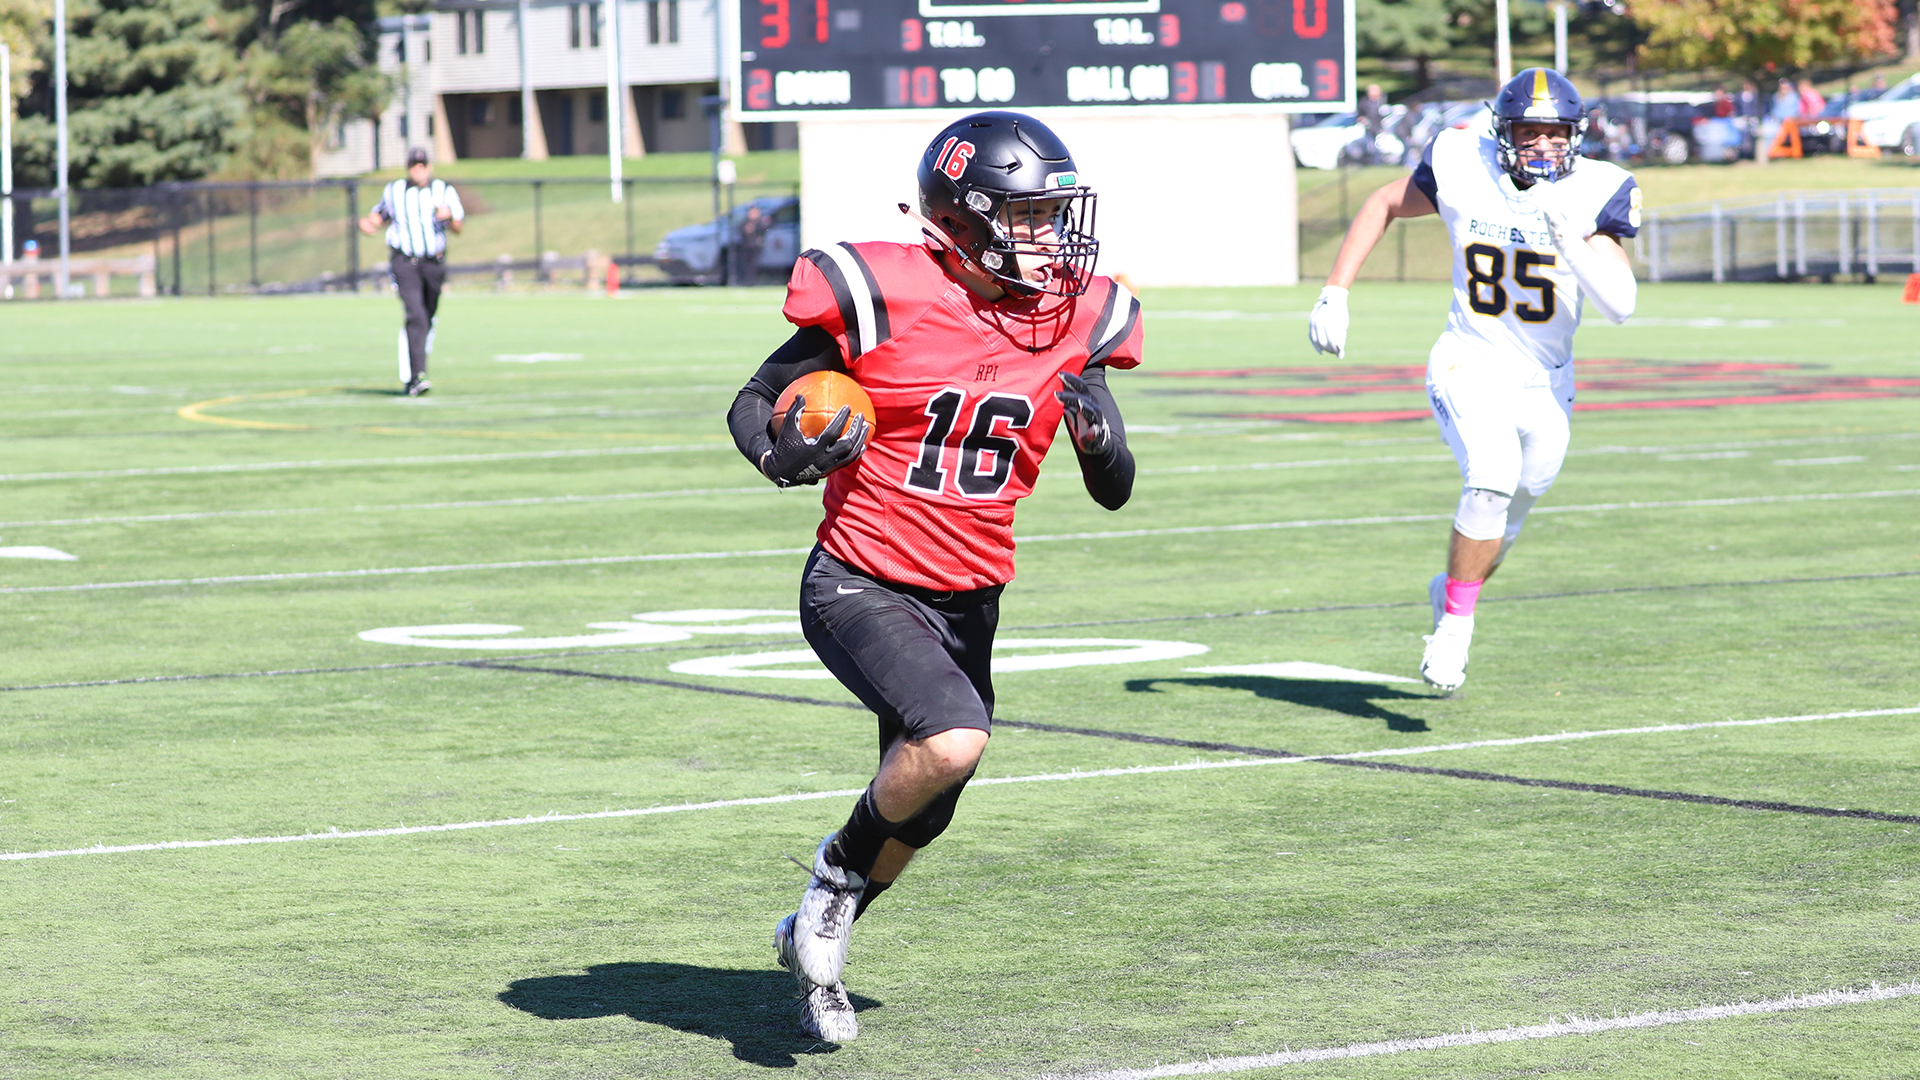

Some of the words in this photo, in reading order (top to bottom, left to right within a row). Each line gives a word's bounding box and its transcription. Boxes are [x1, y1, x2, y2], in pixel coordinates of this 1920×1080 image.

[760, 0, 829, 48] 31
[902, 18, 922, 51] 3
[1160, 14, 1180, 47] 3
[747, 68, 772, 109] 2
[775, 70, 851, 105] DOWN
[898, 66, 937, 107] 10
[939, 67, 977, 103] TO
[977, 66, 1016, 103] GO
[1066, 65, 1131, 101] BALL
[1130, 64, 1169, 101] ON
[1173, 61, 1226, 102] 31
[1314, 59, 1339, 100] 3
[933, 136, 976, 181] 16
[1469, 218, 1554, 247] ROCHESTE
[1464, 241, 1557, 324] 85
[975, 364, 999, 382] RPI
[903, 386, 1035, 499] 16
